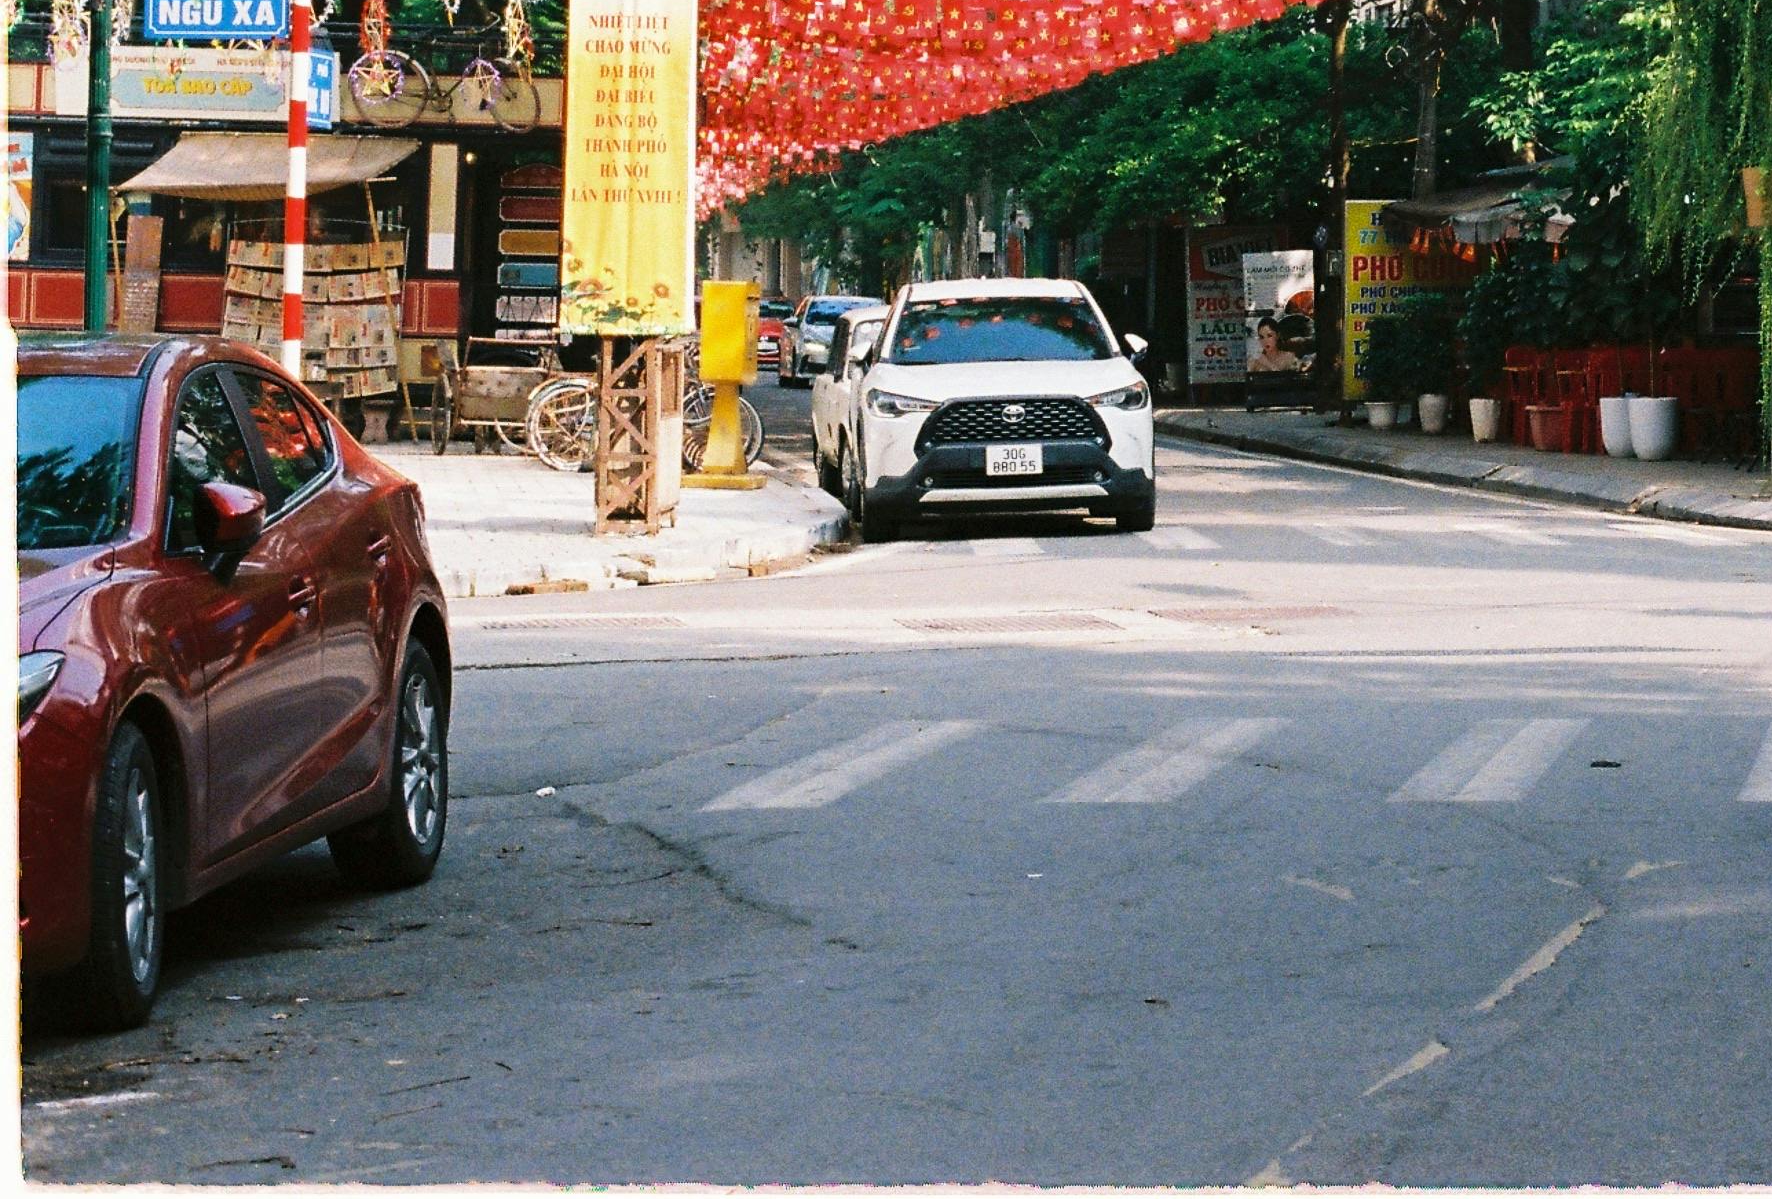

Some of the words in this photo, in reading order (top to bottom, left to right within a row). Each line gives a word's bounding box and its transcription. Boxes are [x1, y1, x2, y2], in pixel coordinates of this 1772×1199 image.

[589, 12, 631, 33] NHIỆT
[636, 12, 670, 33] LIỆT
[600, 64, 624, 83] ĐẠI
[628, 62, 655, 83] HỘI
[596, 89, 620, 107] ĐẠI
[637, 111, 658, 133] BỘ
[637, 134, 667, 153] PHỐ
[600, 159, 619, 178] HÀ
[624, 161, 649, 182] NỘI
[1359, 229, 1379, 244] 77
[1002, 448, 1026, 460] 30G
